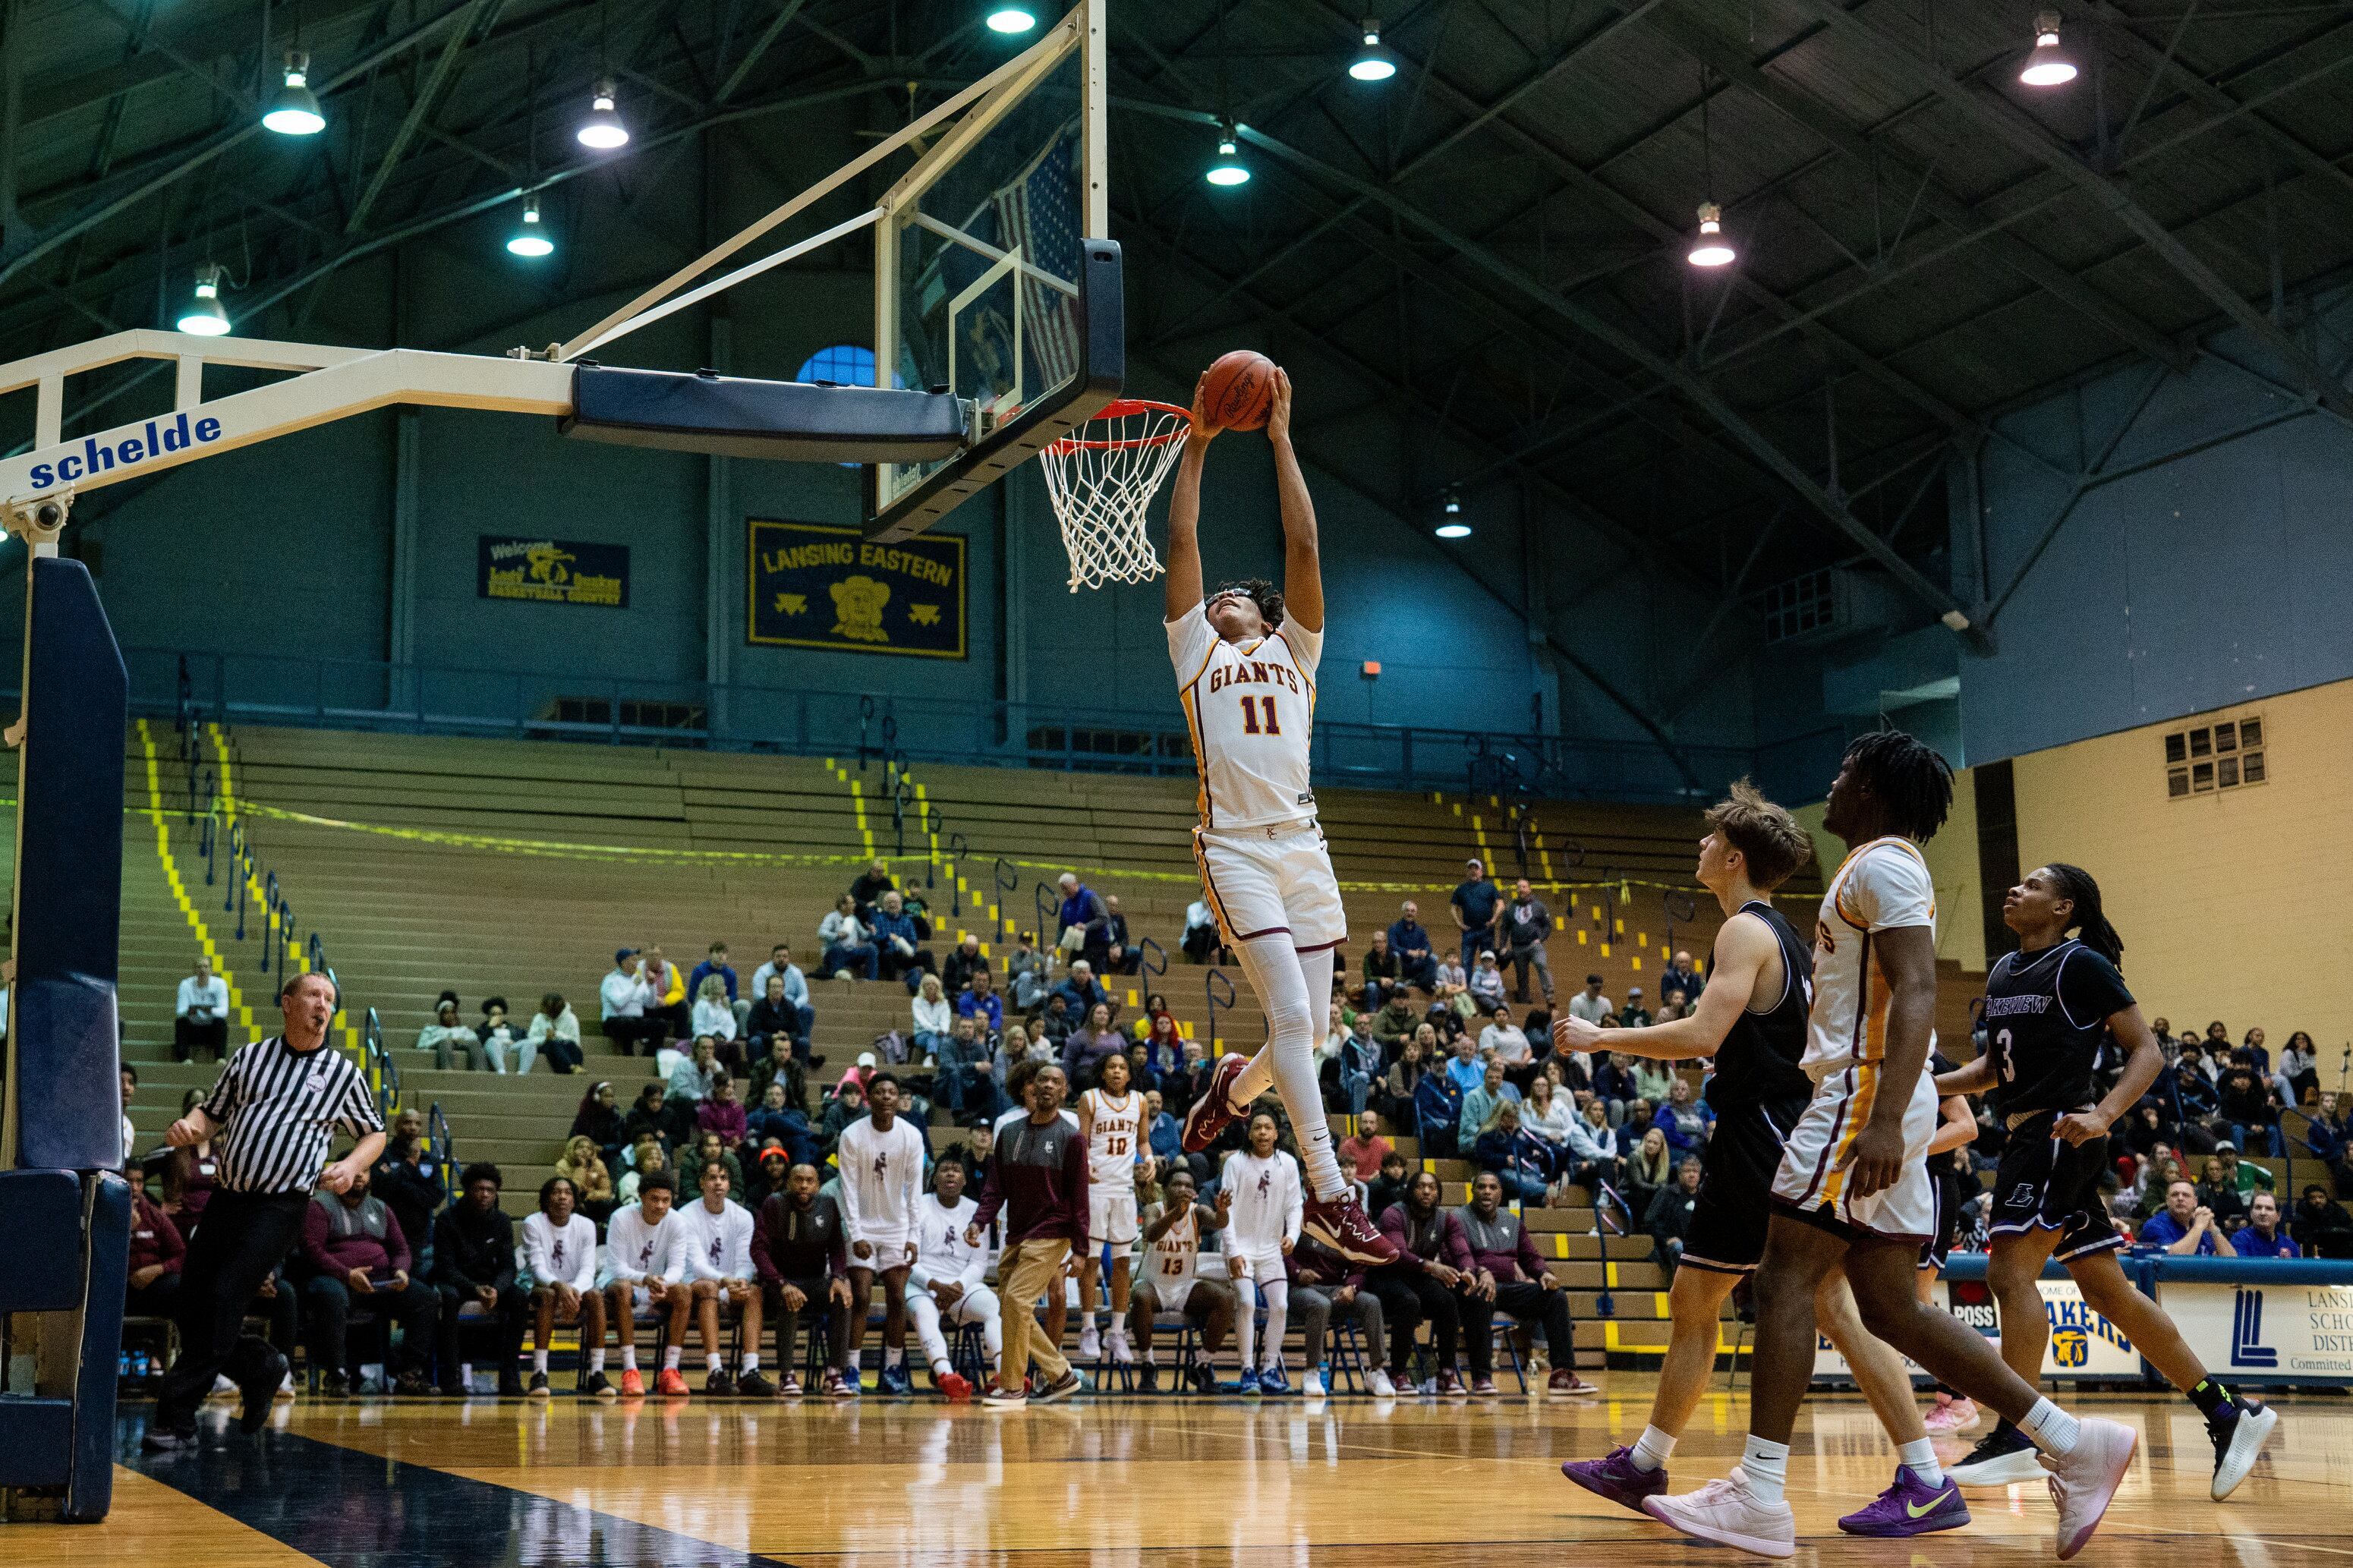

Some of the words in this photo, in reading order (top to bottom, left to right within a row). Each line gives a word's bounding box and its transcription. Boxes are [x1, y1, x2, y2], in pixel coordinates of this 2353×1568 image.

[30, 413, 222, 490] schelde
[763, 543, 854, 574] LANSING
[860, 544, 953, 587] EASTERN
[1210, 661, 1299, 695] GIANTS
[1240, 694, 1282, 737] 11
[1996, 1028, 2016, 1082] 3
[1107, 1137, 1127, 1155] 10
[1162, 1258, 1183, 1276] 13
[2290, 1358, 2352, 1371] Committed
